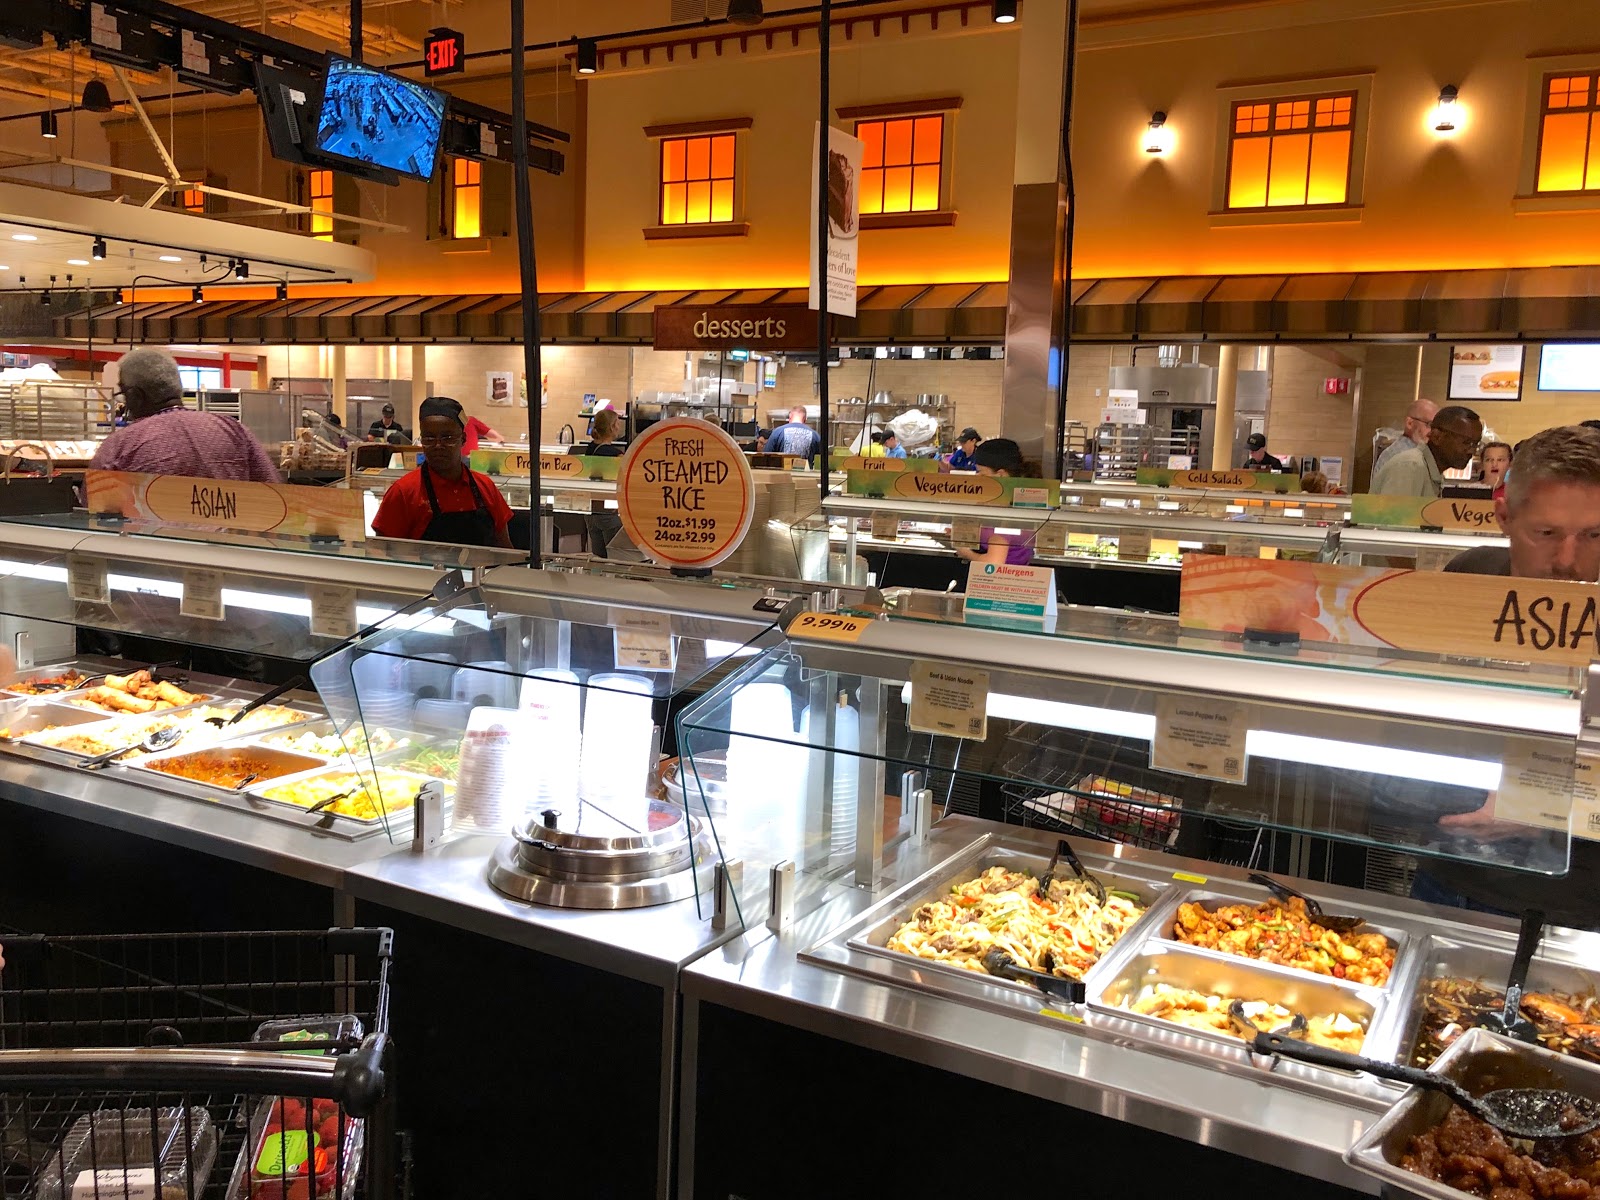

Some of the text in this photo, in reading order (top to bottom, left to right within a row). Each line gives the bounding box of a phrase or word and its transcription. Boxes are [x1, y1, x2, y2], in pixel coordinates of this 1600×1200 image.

[430, 38, 455, 70] EXIT
[693, 311, 786, 338] desserts
[664, 437, 704, 456] FRESH
[516, 455, 572, 471] Proin Bar
[642, 458, 729, 484] STEAMED
[863, 459, 885, 470] Fruit
[914, 475, 984, 495] Vegetarian
[1187, 472, 1243, 485] Cold Salads
[190, 484, 236, 519] ASIAN
[661, 485, 706, 511] RICE
[996, 566, 1034, 577] Allergens
[1493, 590, 1600, 655] ASIA
